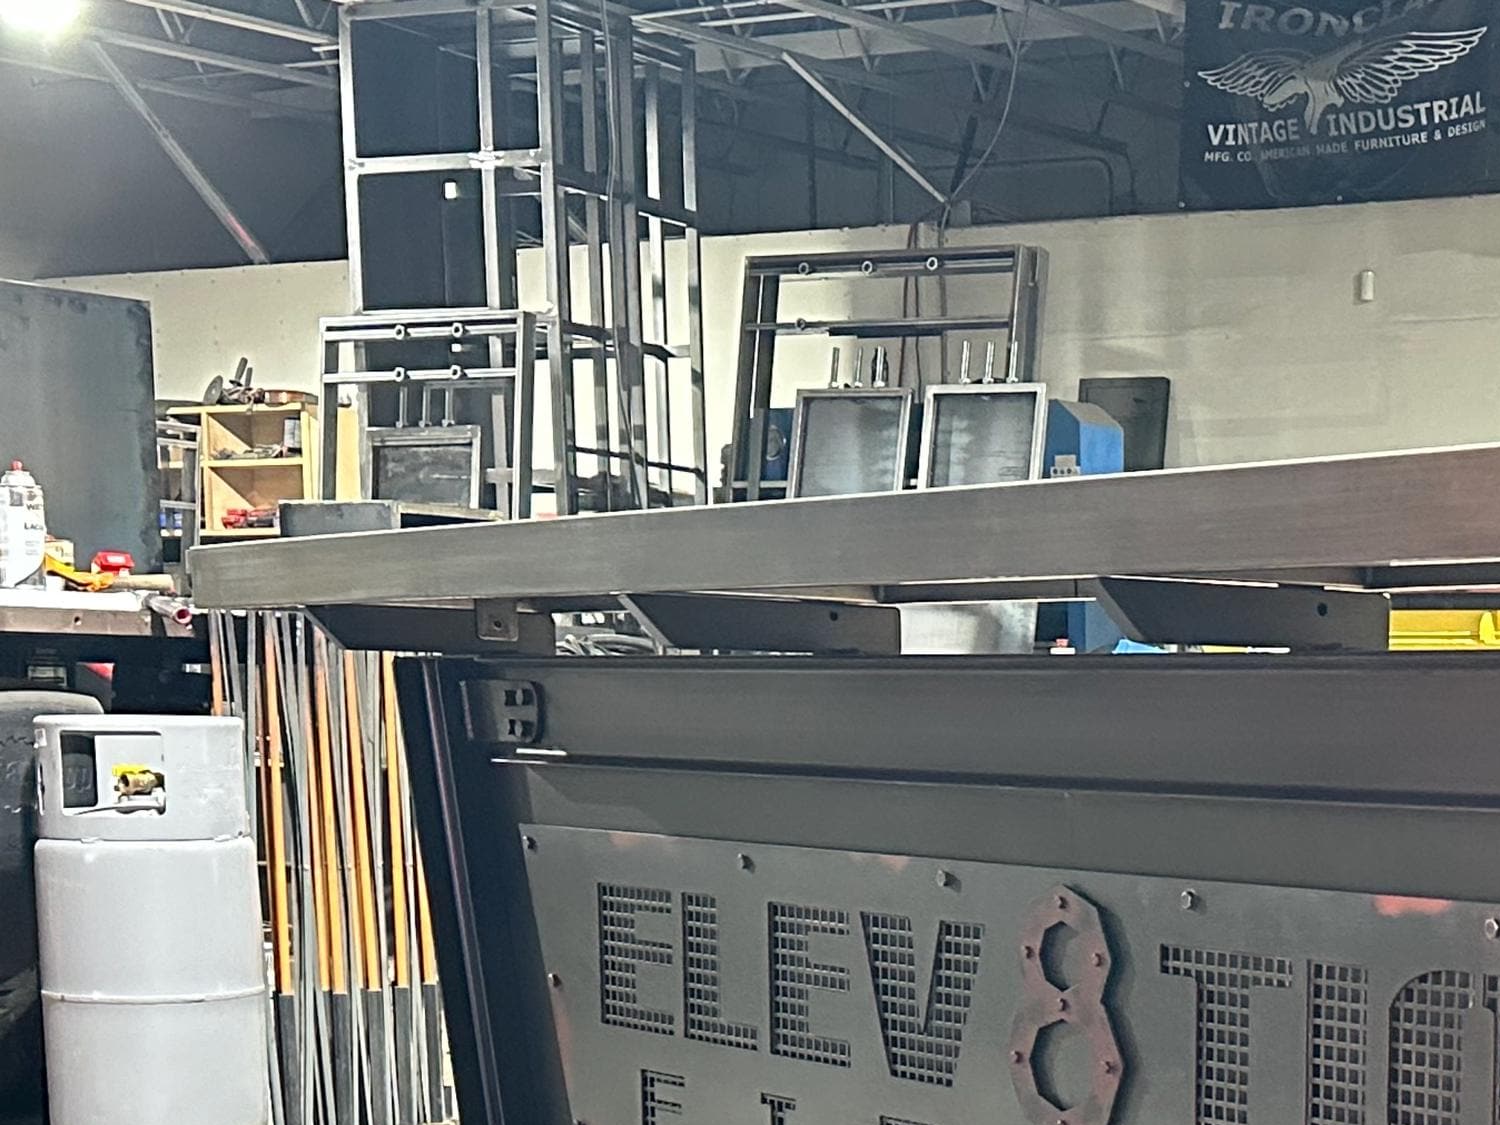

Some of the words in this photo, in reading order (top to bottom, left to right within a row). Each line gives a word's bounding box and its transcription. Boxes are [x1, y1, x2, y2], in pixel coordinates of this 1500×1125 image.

[1207, 118, 1299, 146] VINTAGE
[1327, 91, 1486, 137] INDUSTRIAL
[1316, 141, 1348, 155] MADE
[1354, 132, 1428, 151] FURNITURE
[1433, 131, 1441, 141] &
[1447, 119, 1487, 138] DESIGN
